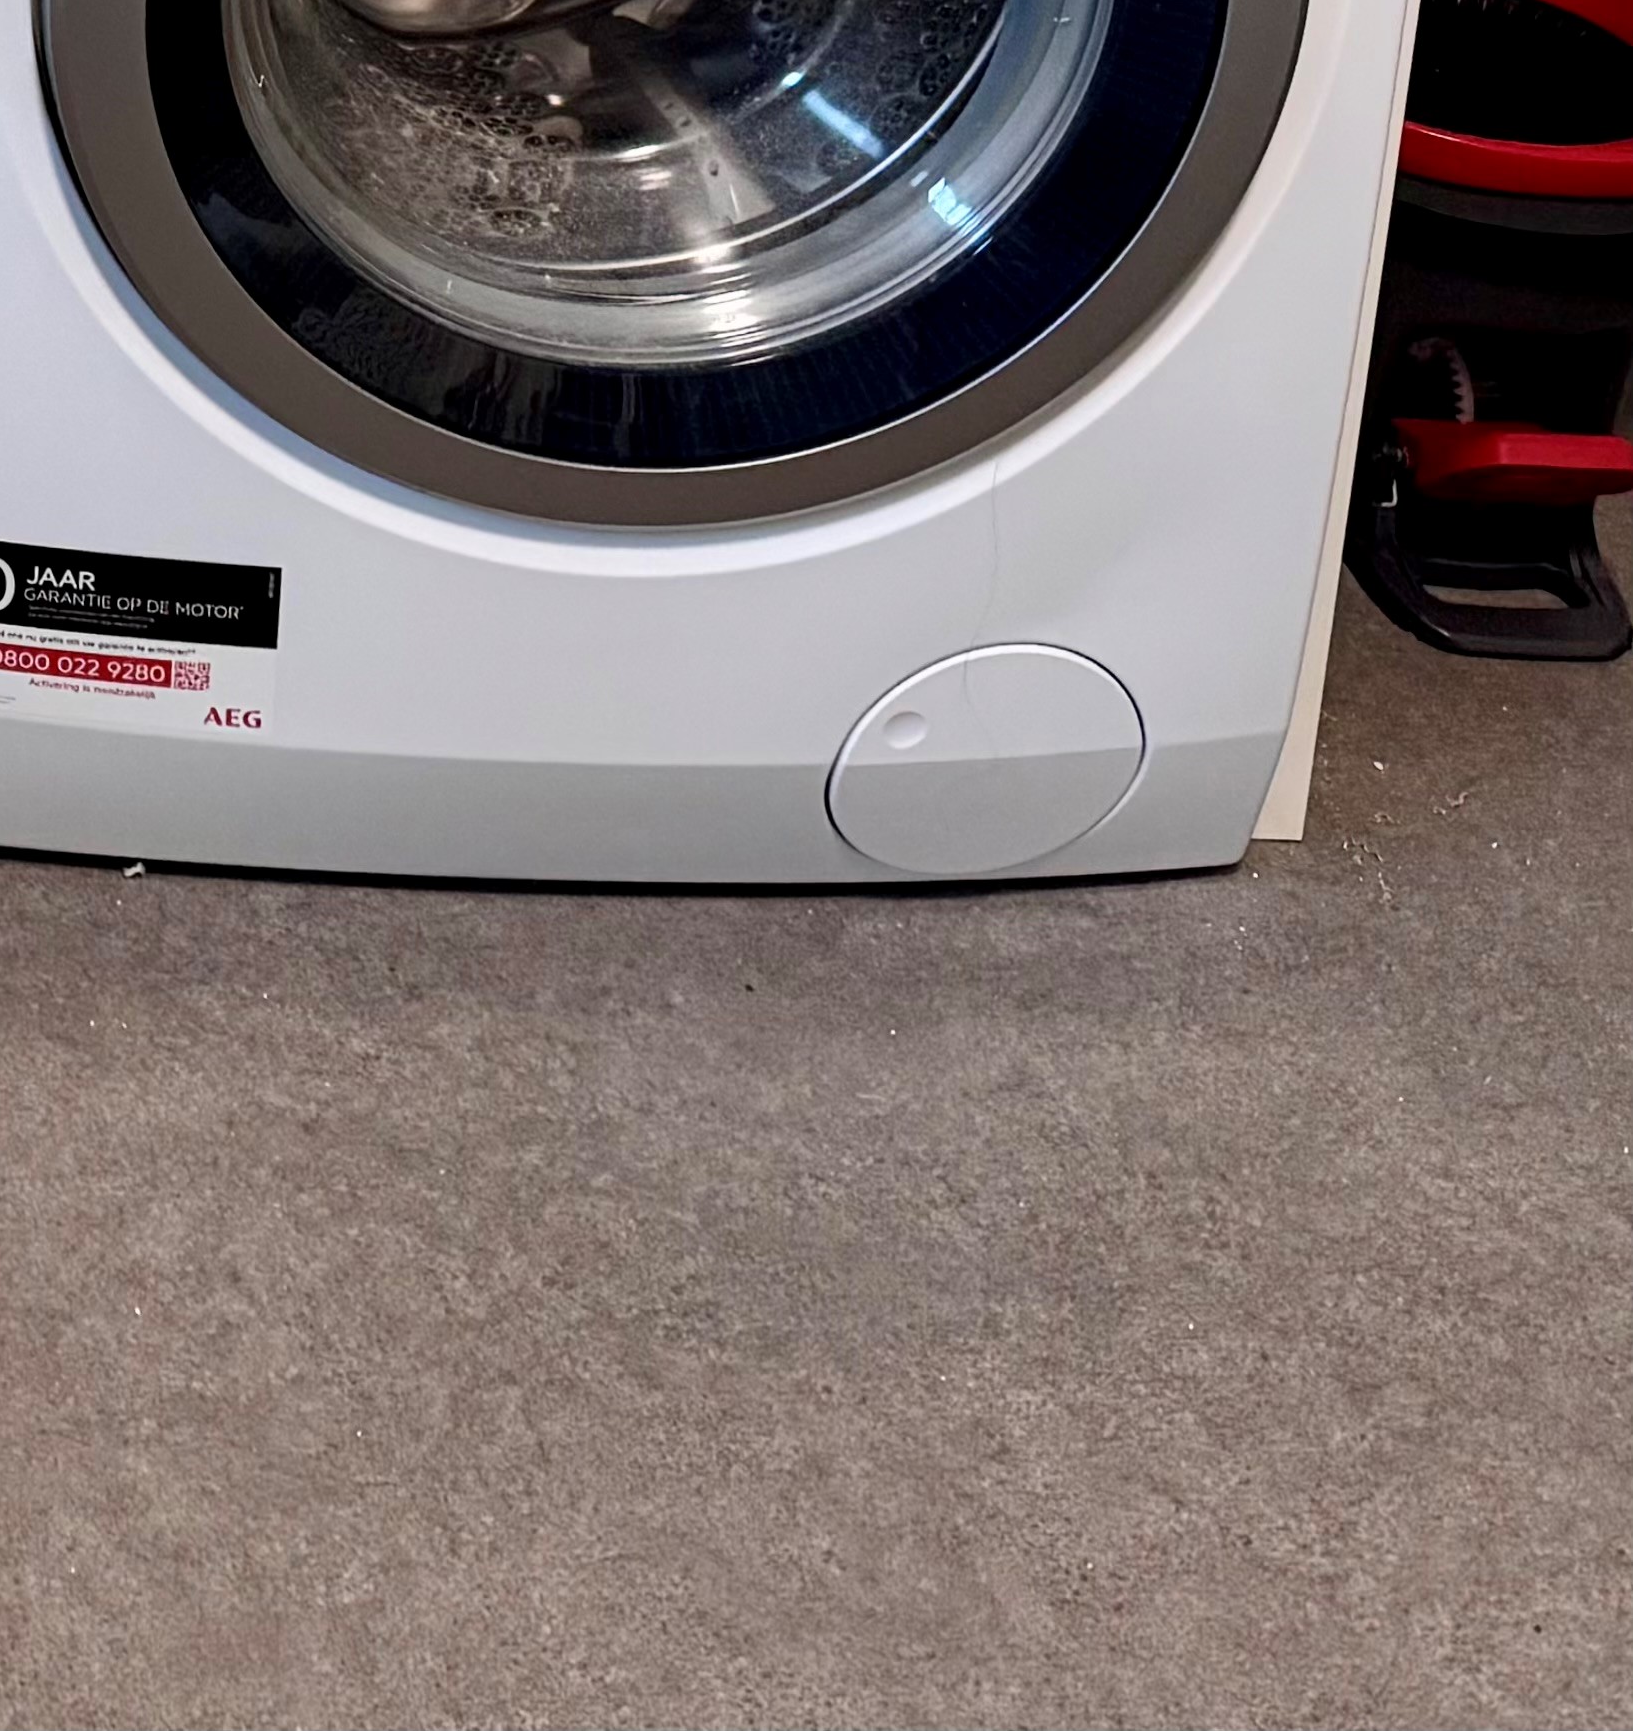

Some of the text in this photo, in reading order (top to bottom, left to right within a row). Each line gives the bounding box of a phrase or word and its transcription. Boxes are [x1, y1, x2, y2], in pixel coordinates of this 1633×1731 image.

[26, 565, 95, 591] JAAR
[24, 587, 111, 610] GARANTIE
[117, 597, 142, 611] OP
[147, 599, 169, 615] DE
[57, 656, 100, 677] 022
[107, 660, 166, 683] 9280
[29, 677, 79, 693] Activering
[203, 706, 262, 729] AEG
